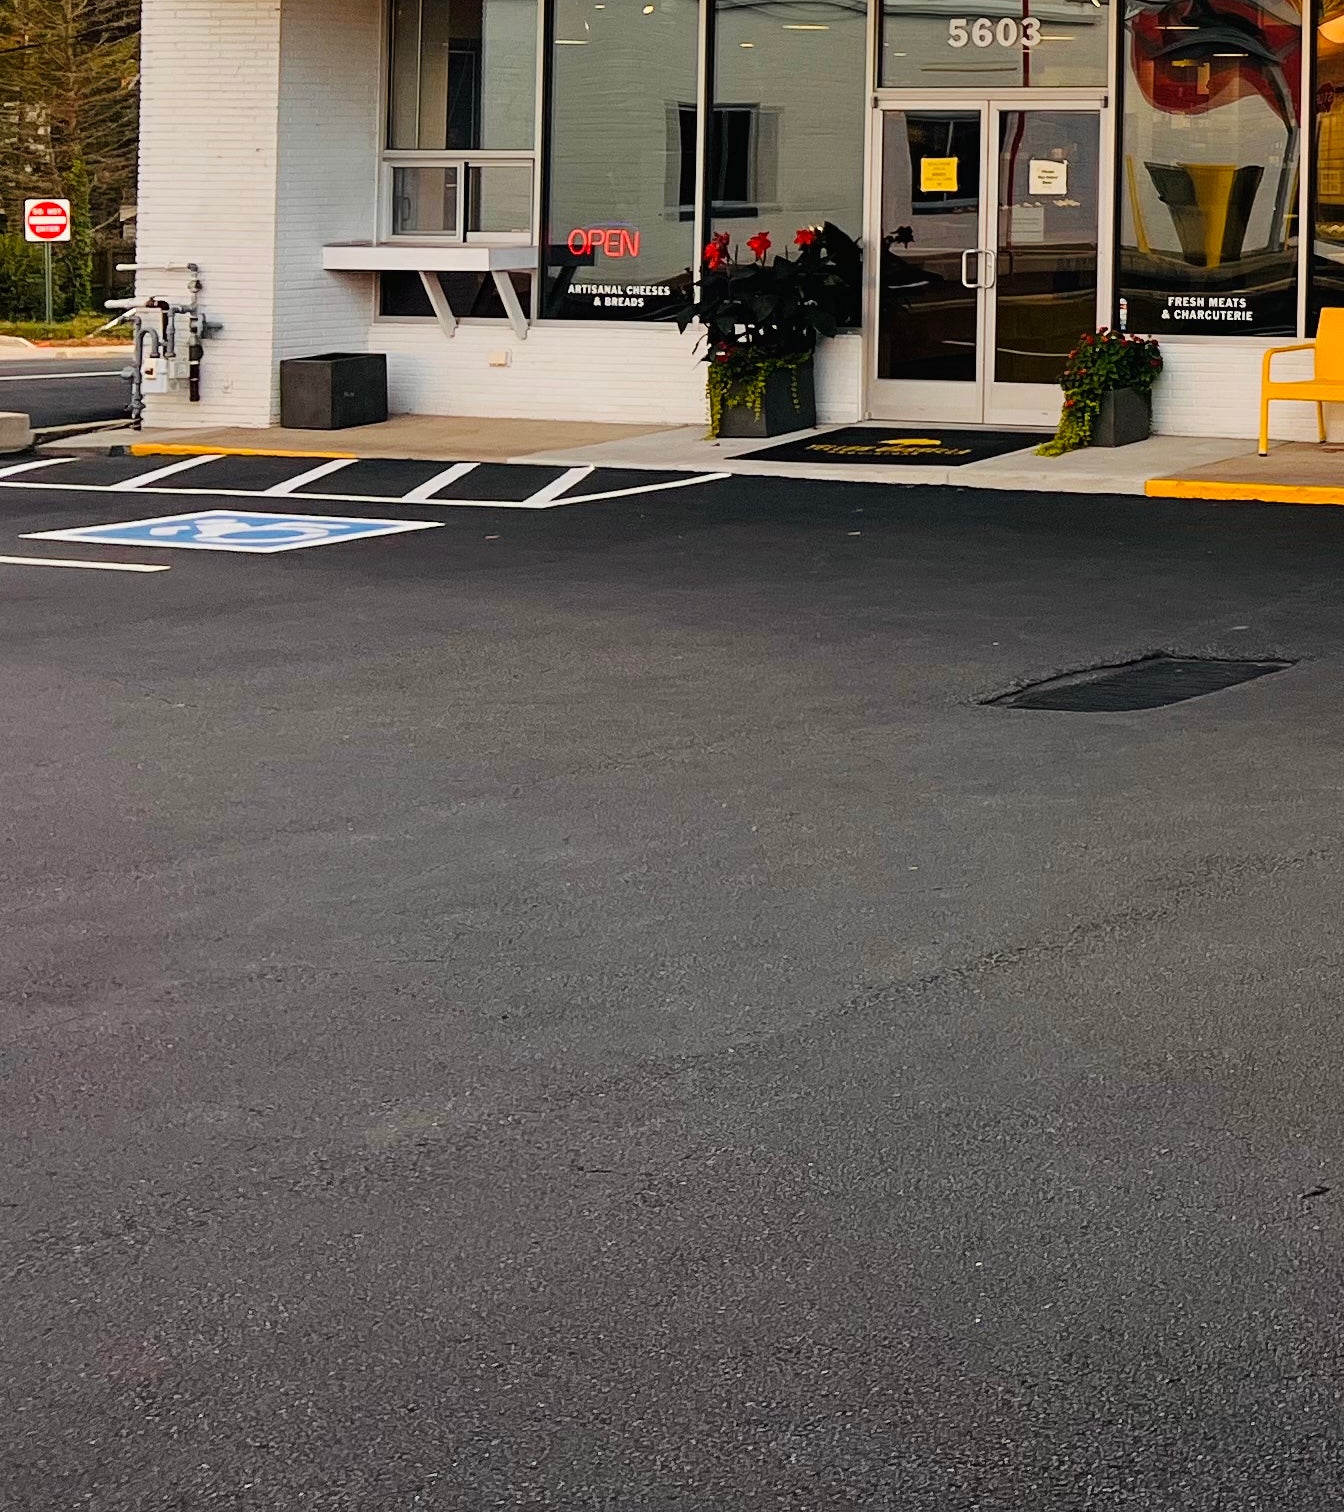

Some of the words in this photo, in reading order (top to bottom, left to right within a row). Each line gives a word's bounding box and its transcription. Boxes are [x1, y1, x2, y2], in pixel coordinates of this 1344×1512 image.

[947, 17, 1041, 48] 5603
[567, 227, 641, 258] OPEN
[567, 284, 624, 294] ARTISANAL
[625, 285, 671, 296] CHEESES
[593, 296, 602, 306] &
[604, 296, 645, 307] BREADS
[1167, 296, 1205, 307] FRESH
[1208, 297, 1247, 308] MEATS
[1161, 309, 1171, 320] &
[1173, 309, 1254, 321] CHARCUTERIE
